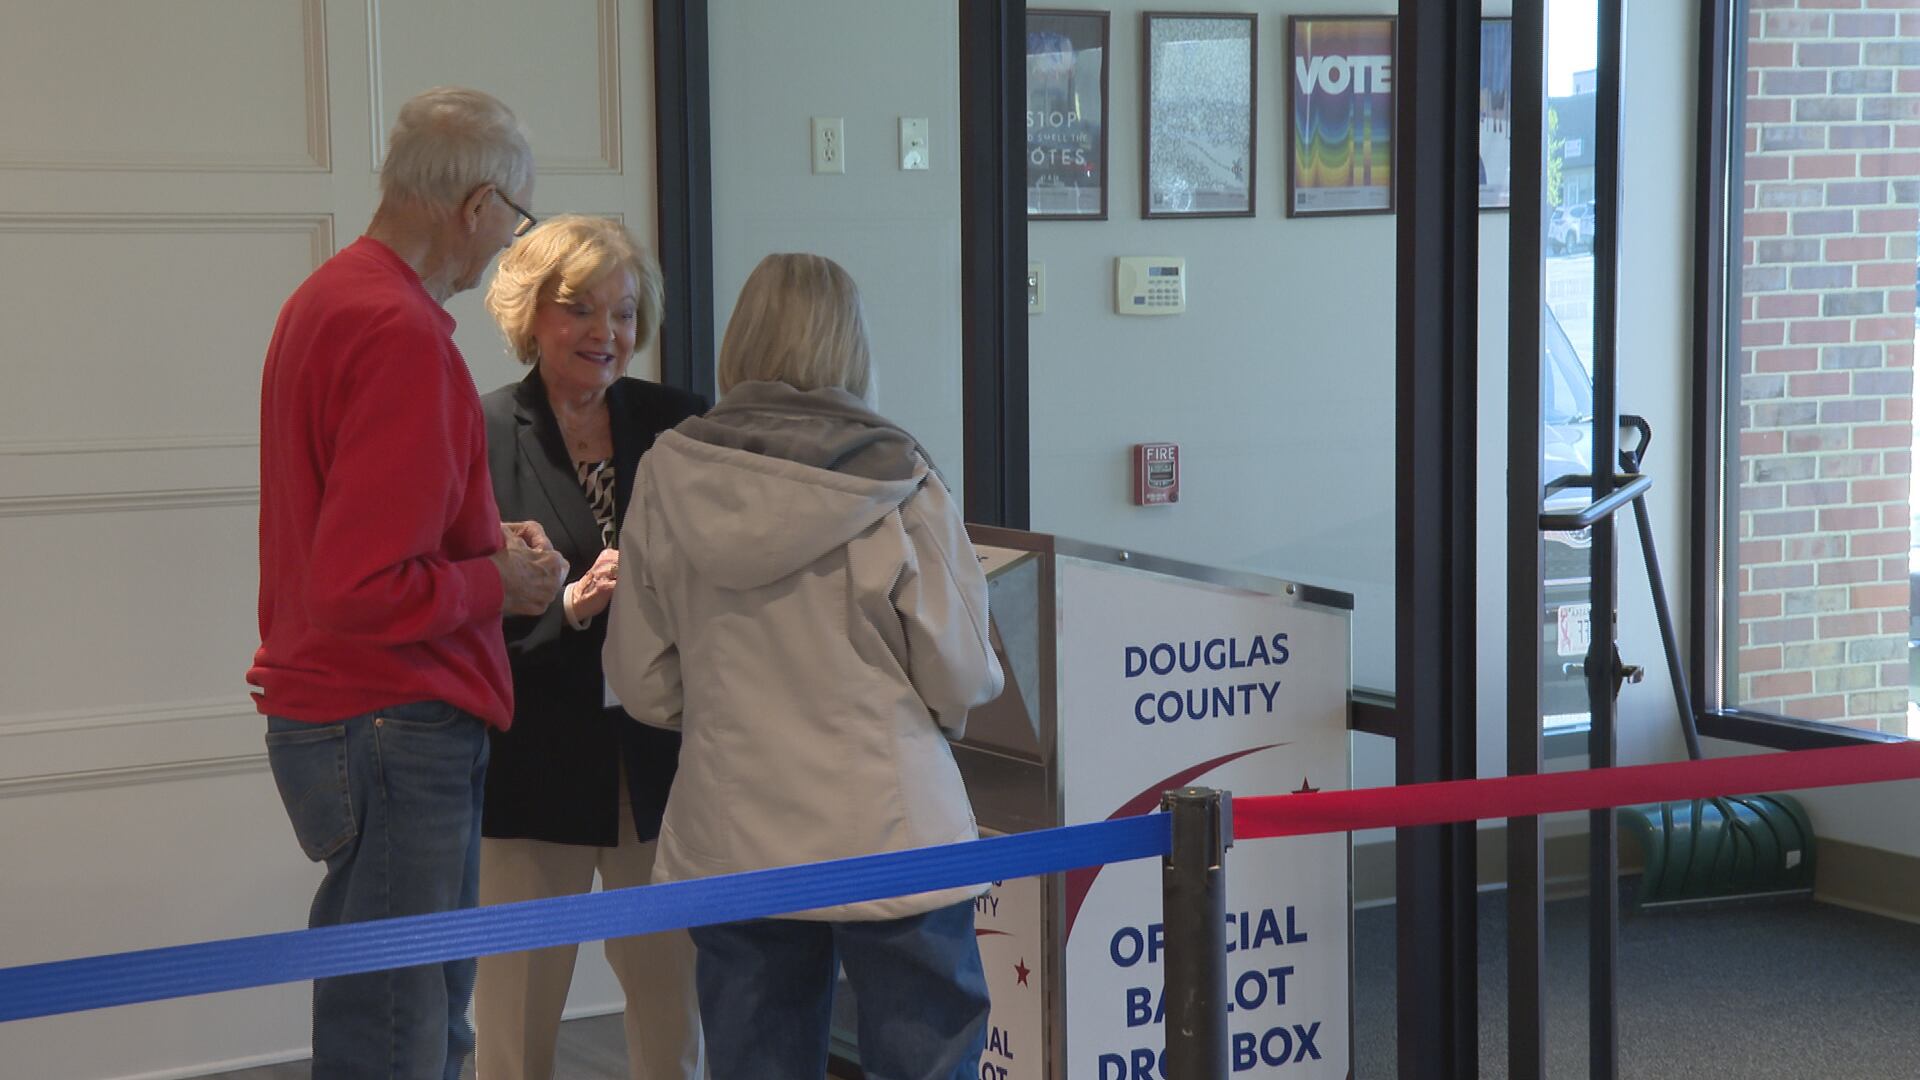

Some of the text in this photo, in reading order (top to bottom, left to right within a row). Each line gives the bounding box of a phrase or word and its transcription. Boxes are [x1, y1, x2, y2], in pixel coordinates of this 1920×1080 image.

[1295, 54, 1392, 95] VOTE
[1027, 111, 1077, 128] STOP
[1027, 147, 1085, 165] OTES
[1146, 447, 1175, 461] FIRE
[1125, 632, 1289, 678] DOUGLAS
[1134, 681, 1281, 725] COUNTY
[1232, 1021, 1322, 1073] BOX
